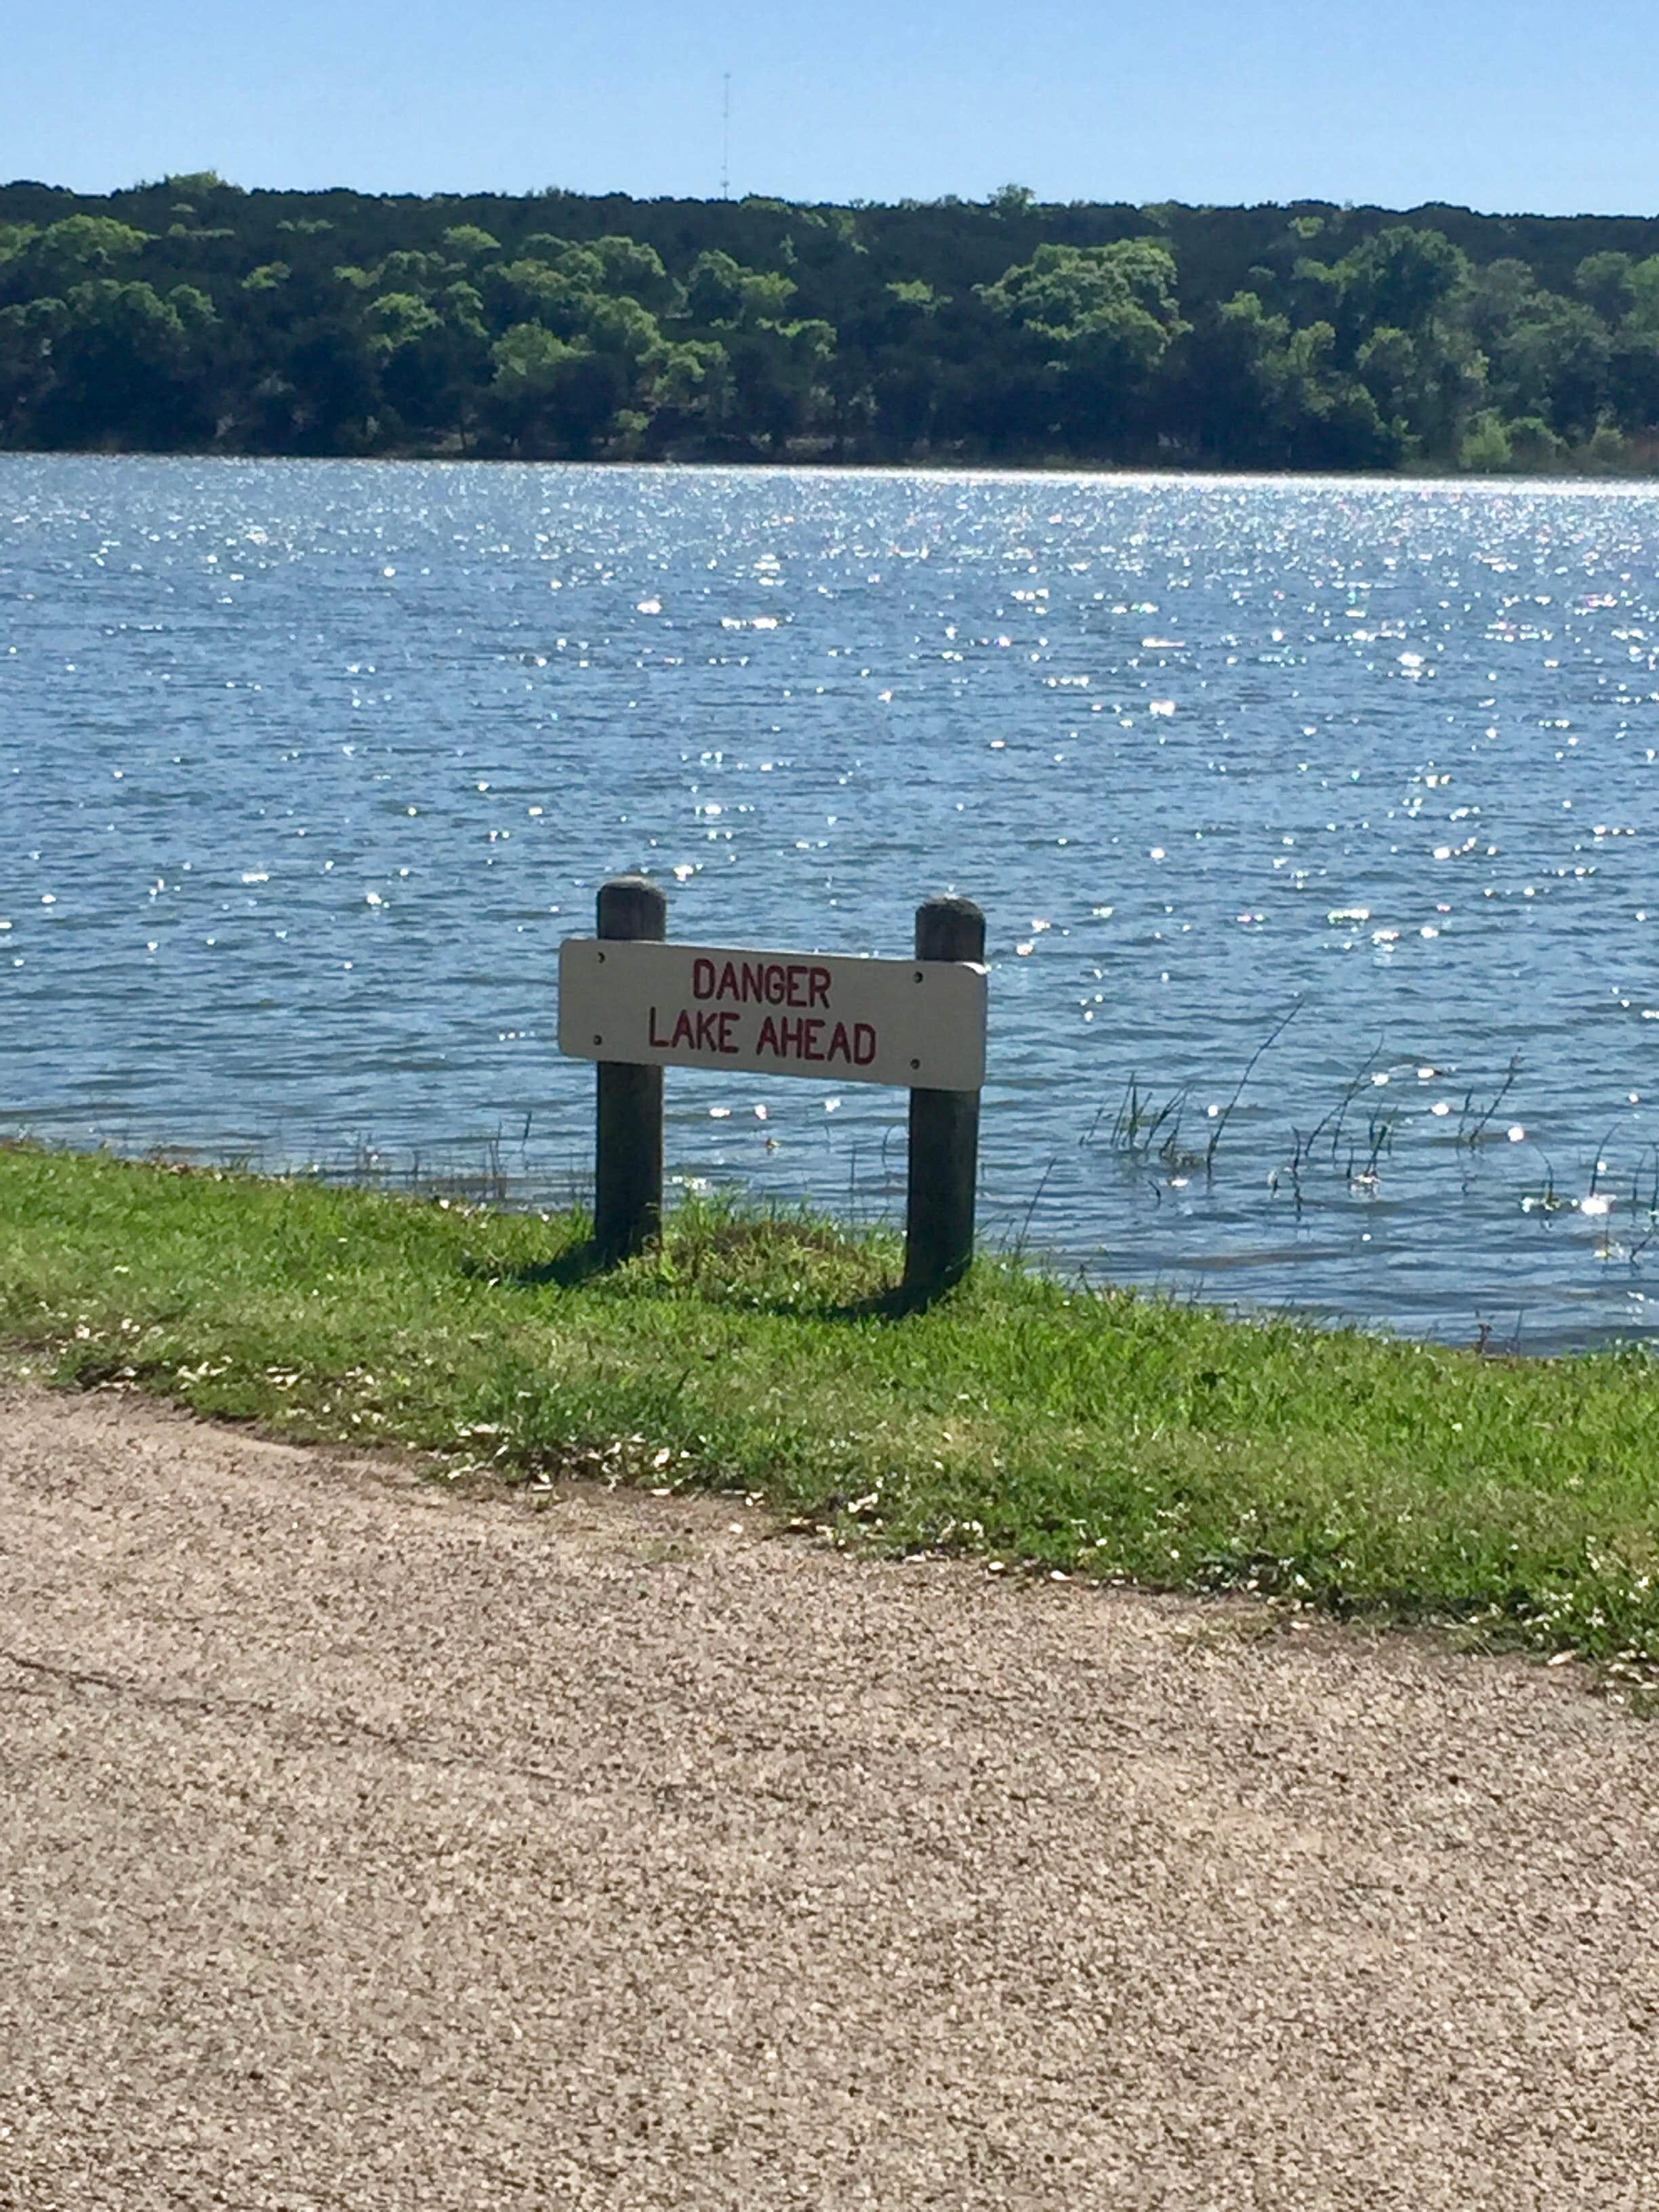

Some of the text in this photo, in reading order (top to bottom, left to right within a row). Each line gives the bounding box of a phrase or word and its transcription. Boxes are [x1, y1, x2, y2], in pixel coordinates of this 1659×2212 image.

[693, 958, 831, 1009] DANGER
[649, 1006, 877, 1065] LAKE AHEAD
